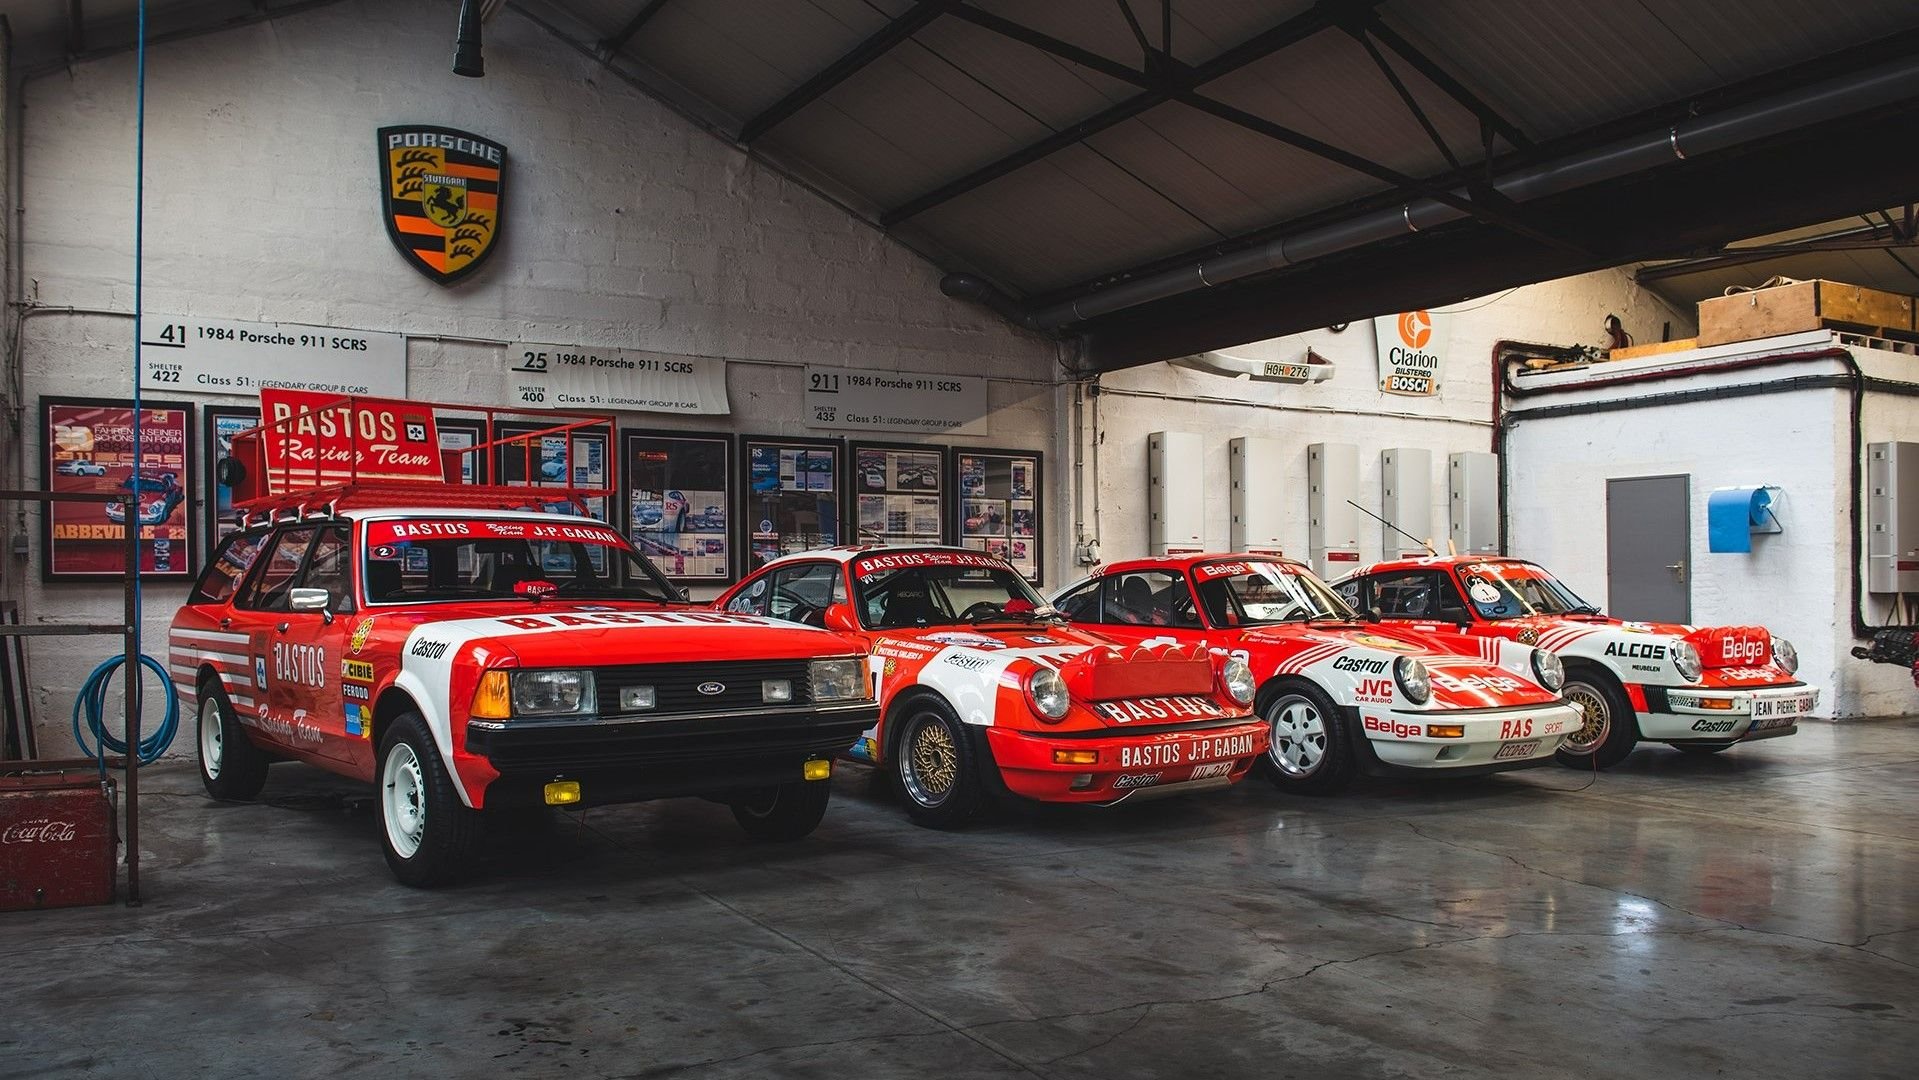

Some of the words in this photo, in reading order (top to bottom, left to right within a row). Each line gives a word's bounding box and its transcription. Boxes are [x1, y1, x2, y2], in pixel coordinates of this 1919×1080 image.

[388, 132, 501, 164] PORSCHE
[423, 174, 466, 187] STUTTGART
[160, 324, 186, 345] 41
[197, 326, 235, 341] 1984
[239, 329, 296, 346] Porsche
[300, 334, 326, 348] 911
[331, 337, 368, 351] SCRS
[523, 351, 548, 369] 25
[556, 353, 586, 367] 1984
[590, 355, 635, 370] Porsche
[638, 360, 659, 371] 911
[664, 361, 694, 374] SCRS
[1389, 346, 1438, 369] Clarion
[149, 362, 183, 371] SHELTER
[1290, 366, 1308, 378] 276
[1395, 367, 1432, 378] BILSTEREO
[152, 371, 180, 383] 422
[197, 374, 232, 387] Class
[236, 376, 256, 387] 51:
[257, 379, 307, 390] LEGENDARY
[308, 383, 339, 393] GROUP
[340, 385, 346, 393] B
[347, 385, 369, 394] CARS
[811, 373, 839, 390] 911
[846, 375, 872, 387] 1984
[875, 377, 913, 390] Porsche
[915, 380, 934, 391] 911
[937, 381, 962, 393] SCRS
[1391, 376, 1430, 392] BOSCH
[521, 392, 545, 403] 400
[557, 394, 586, 404] Class
[589, 395, 605, 404] 51:
[607, 397, 647, 406] LEGENDARY
[648, 400, 673, 408] GROUP
[273, 402, 397, 442] BASTOS
[816, 411, 835, 422] 435
[846, 414, 870, 424] Class
[872, 416, 886, 424] 51:
[94, 427, 134, 435] FAHREN
[154, 435, 182, 443] FORM
[278, 439, 364, 465] Raing
[370, 444, 432, 466] Team
[751, 448, 763, 458] RS
[665, 501, 678, 511] RS
[53, 524, 155, 539] ABBEVIE
[392, 523, 470, 537] BASTOS
[485, 523, 524, 533] Racing
[562, 527, 617, 544] GABAN
[379, 547, 389, 556] 2
[861, 554, 924, 571] BASTOS
[1201, 563, 1244, 576] Belga
[527, 585, 555, 595] BAST
[500, 613, 770, 630] BASTOS
[411, 636, 451, 660] Castrol
[1604, 641, 1667, 660] ALCOS
[1722, 636, 1764, 665] Belga
[275, 641, 326, 689] BASTOS
[943, 652, 995, 673] Castrol
[1332, 655, 1389, 675] Castrol
[1631, 664, 1661, 673] MEUBELEN
[1432, 673, 1525, 694] Belga
[1728, 667, 1776, 683] Belga
[343, 684, 369, 700] FERODO
[1355, 678, 1393, 697] JVC
[1355, 695, 1370, 703] CAR
[1371, 696, 1393, 704] AUDIO
[1754, 701, 1773, 716] JEAN
[1776, 699, 1797, 714] PIERRE
[1798, 697, 1814, 712] GABAN
[1102, 697, 1220, 724] BASTOS
[258, 703, 295, 745] Racing
[293, 709, 324, 744] Team
[1364, 715, 1422, 738] Belga
[1500, 718, 1533, 740] RAS
[1544, 721, 1564, 734] SPORT
[1691, 719, 1736, 733] Castrol
[1122, 744, 1181, 768] BASTOS
[1214, 735, 1253, 758] GABAN
[1113, 772, 1162, 789] Castrol
